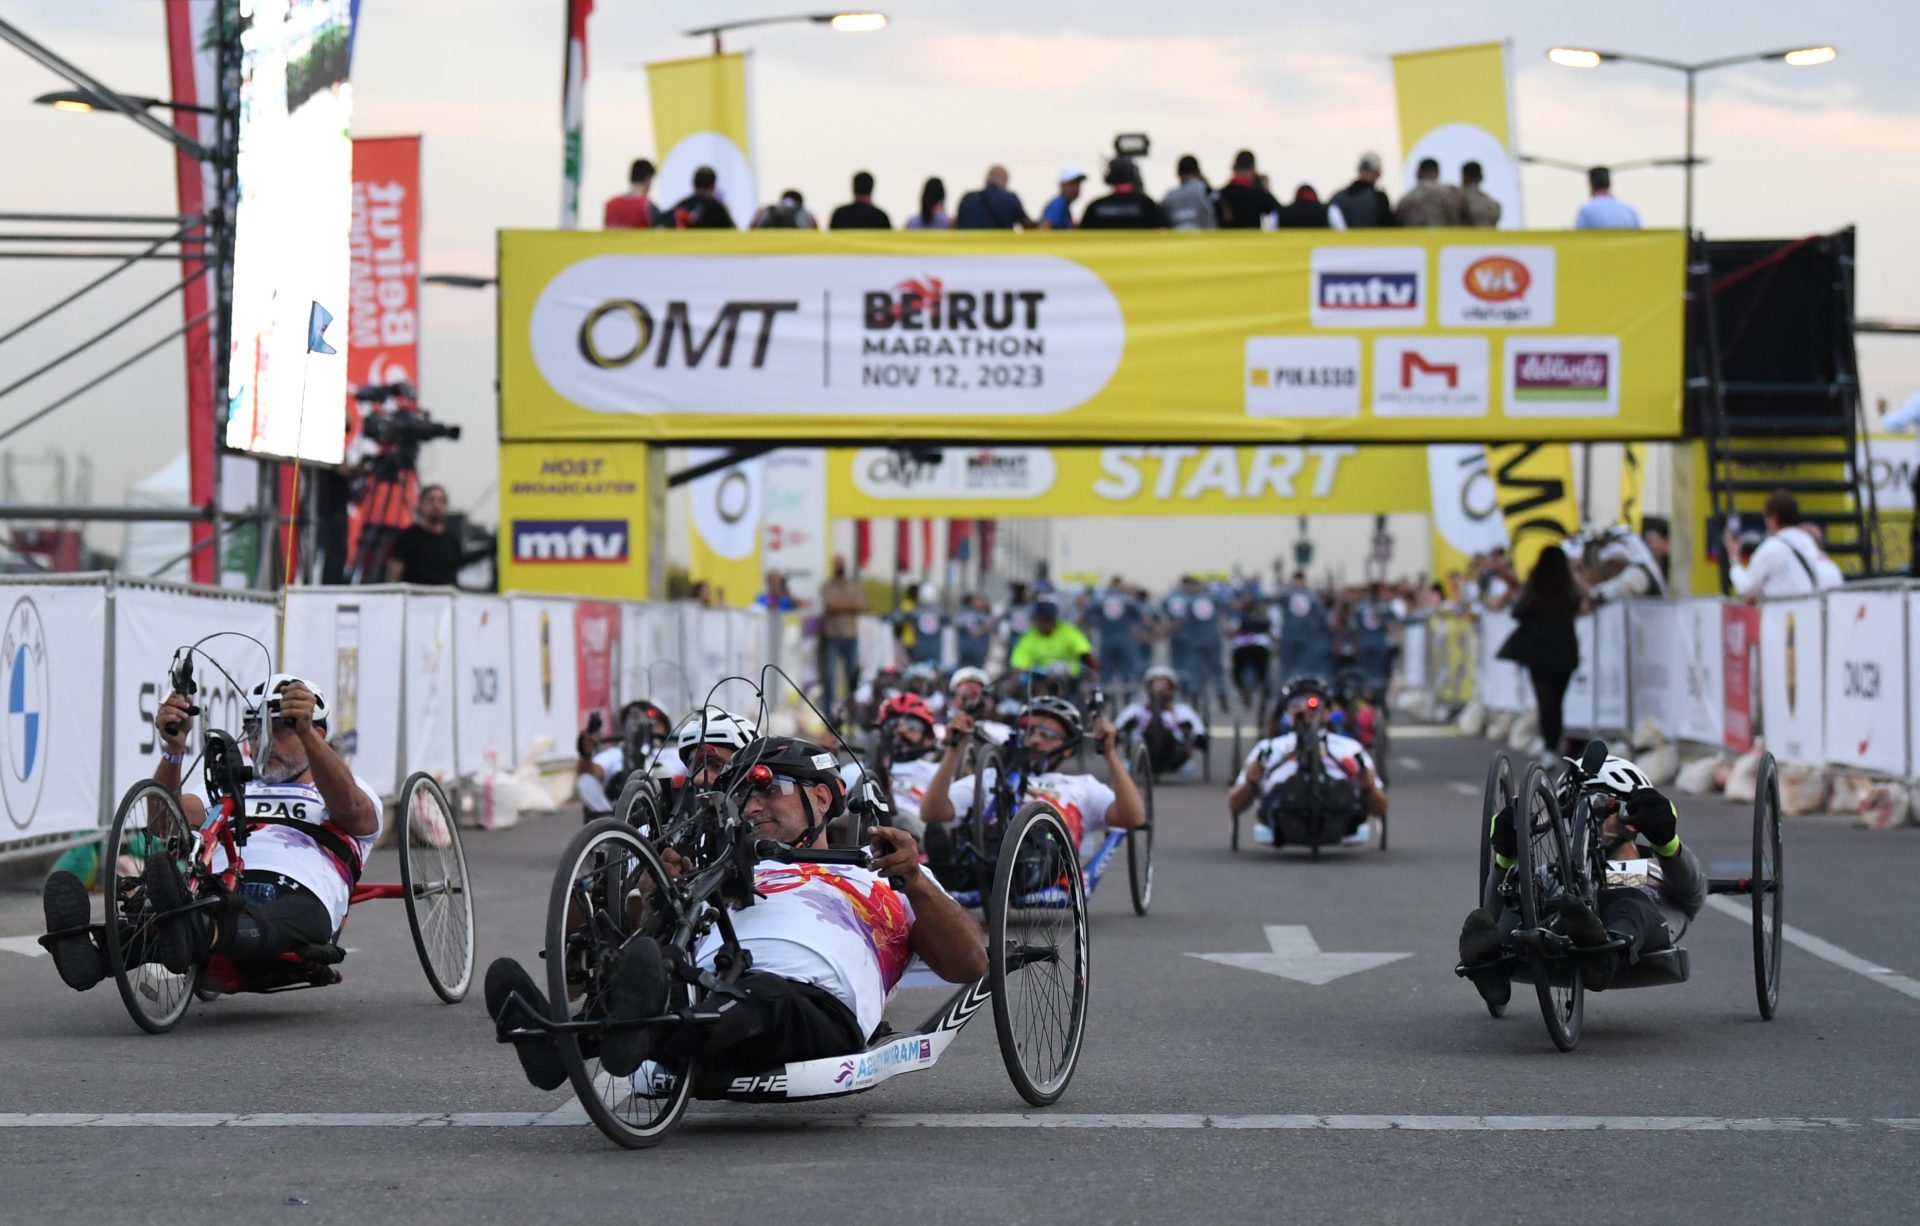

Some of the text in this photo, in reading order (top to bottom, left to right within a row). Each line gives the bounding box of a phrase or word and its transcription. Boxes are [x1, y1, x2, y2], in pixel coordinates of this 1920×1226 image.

[1324, 277, 1413, 305] mtv
[863, 288, 1046, 331] BEIRUT
[577, 300, 799, 370] OMT
[861, 336, 1046, 357] MARATHON
[861, 363, 1045, 390] NOV 12, 2023
[1275, 367, 1356, 387] PIKASSO
[541, 458, 605, 476] HOST
[1092, 446, 1358, 500] START
[518, 525, 623, 560] mtv
[255, 802, 307, 819] PA6
